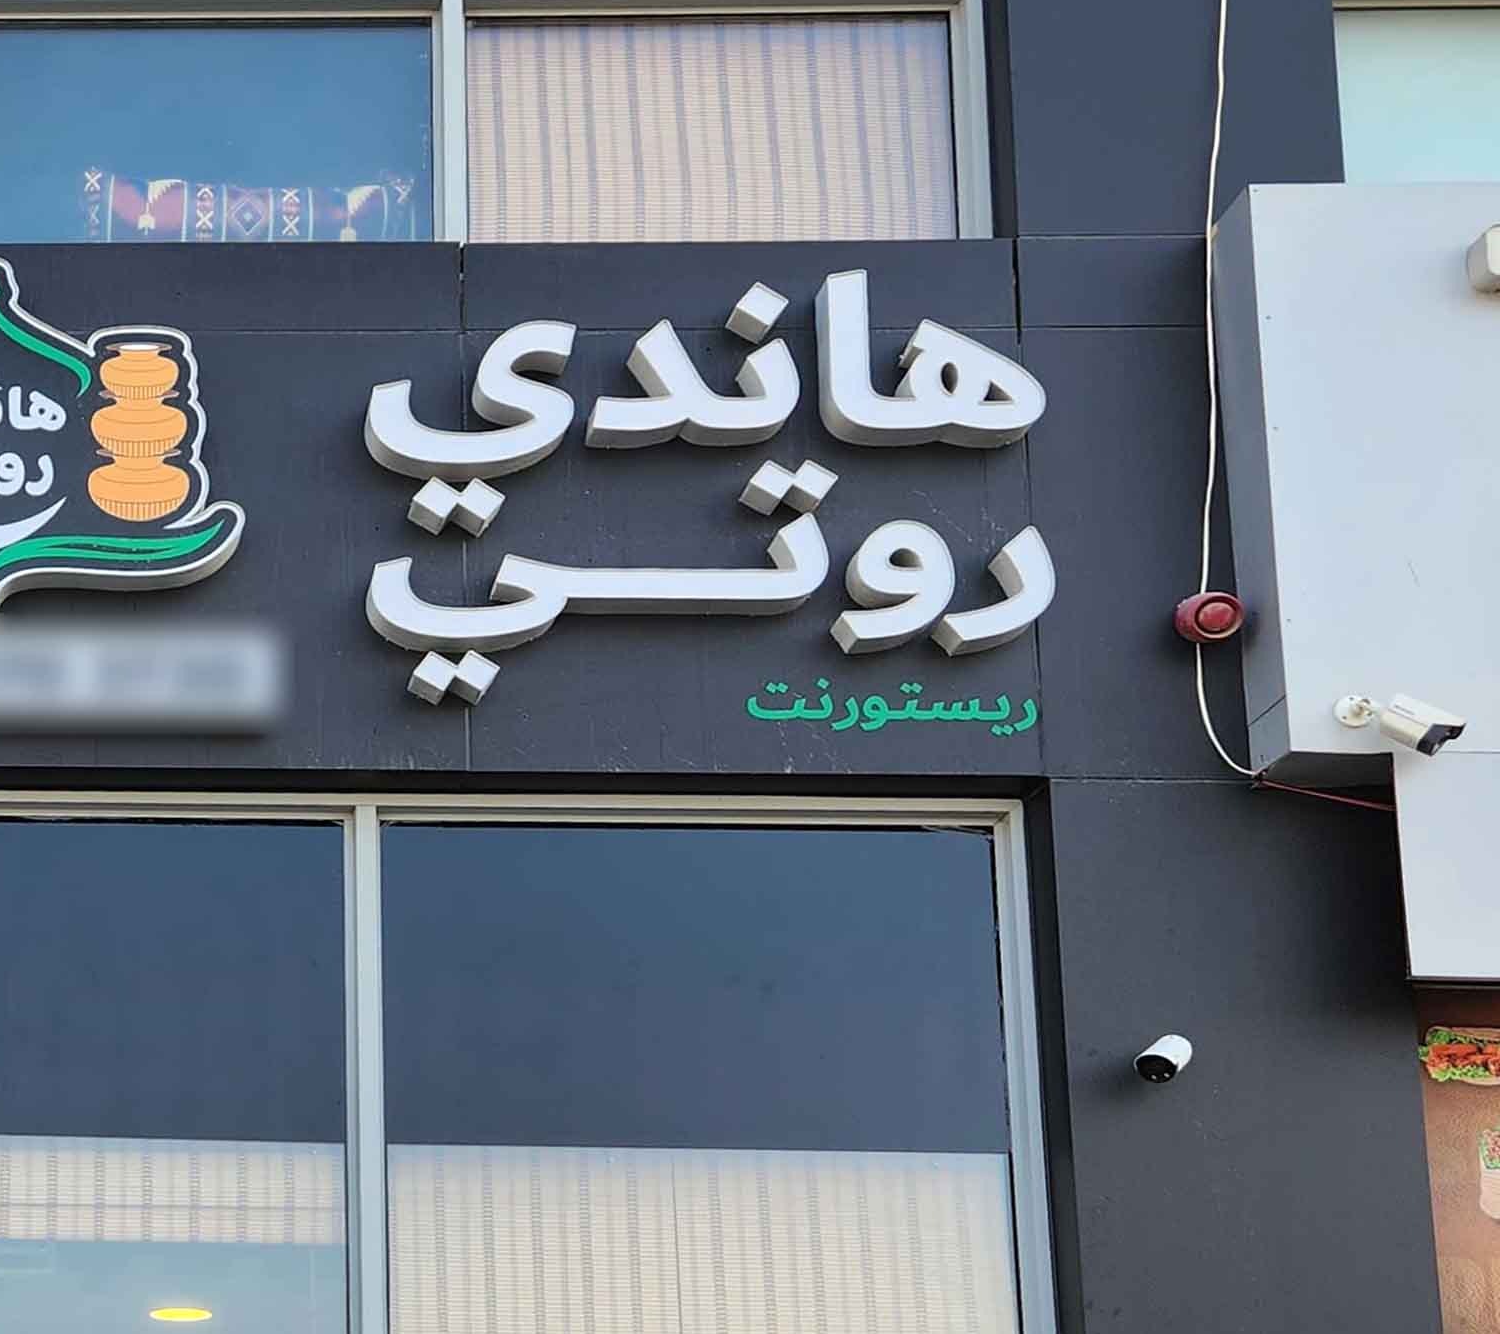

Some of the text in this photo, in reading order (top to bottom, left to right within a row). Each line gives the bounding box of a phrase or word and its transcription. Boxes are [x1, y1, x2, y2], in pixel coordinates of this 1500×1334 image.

[364, 269, 1048, 537] هاندي
[365, 460, 1056, 706] روتي
[746, 679, 1038, 737] ريستورنت
